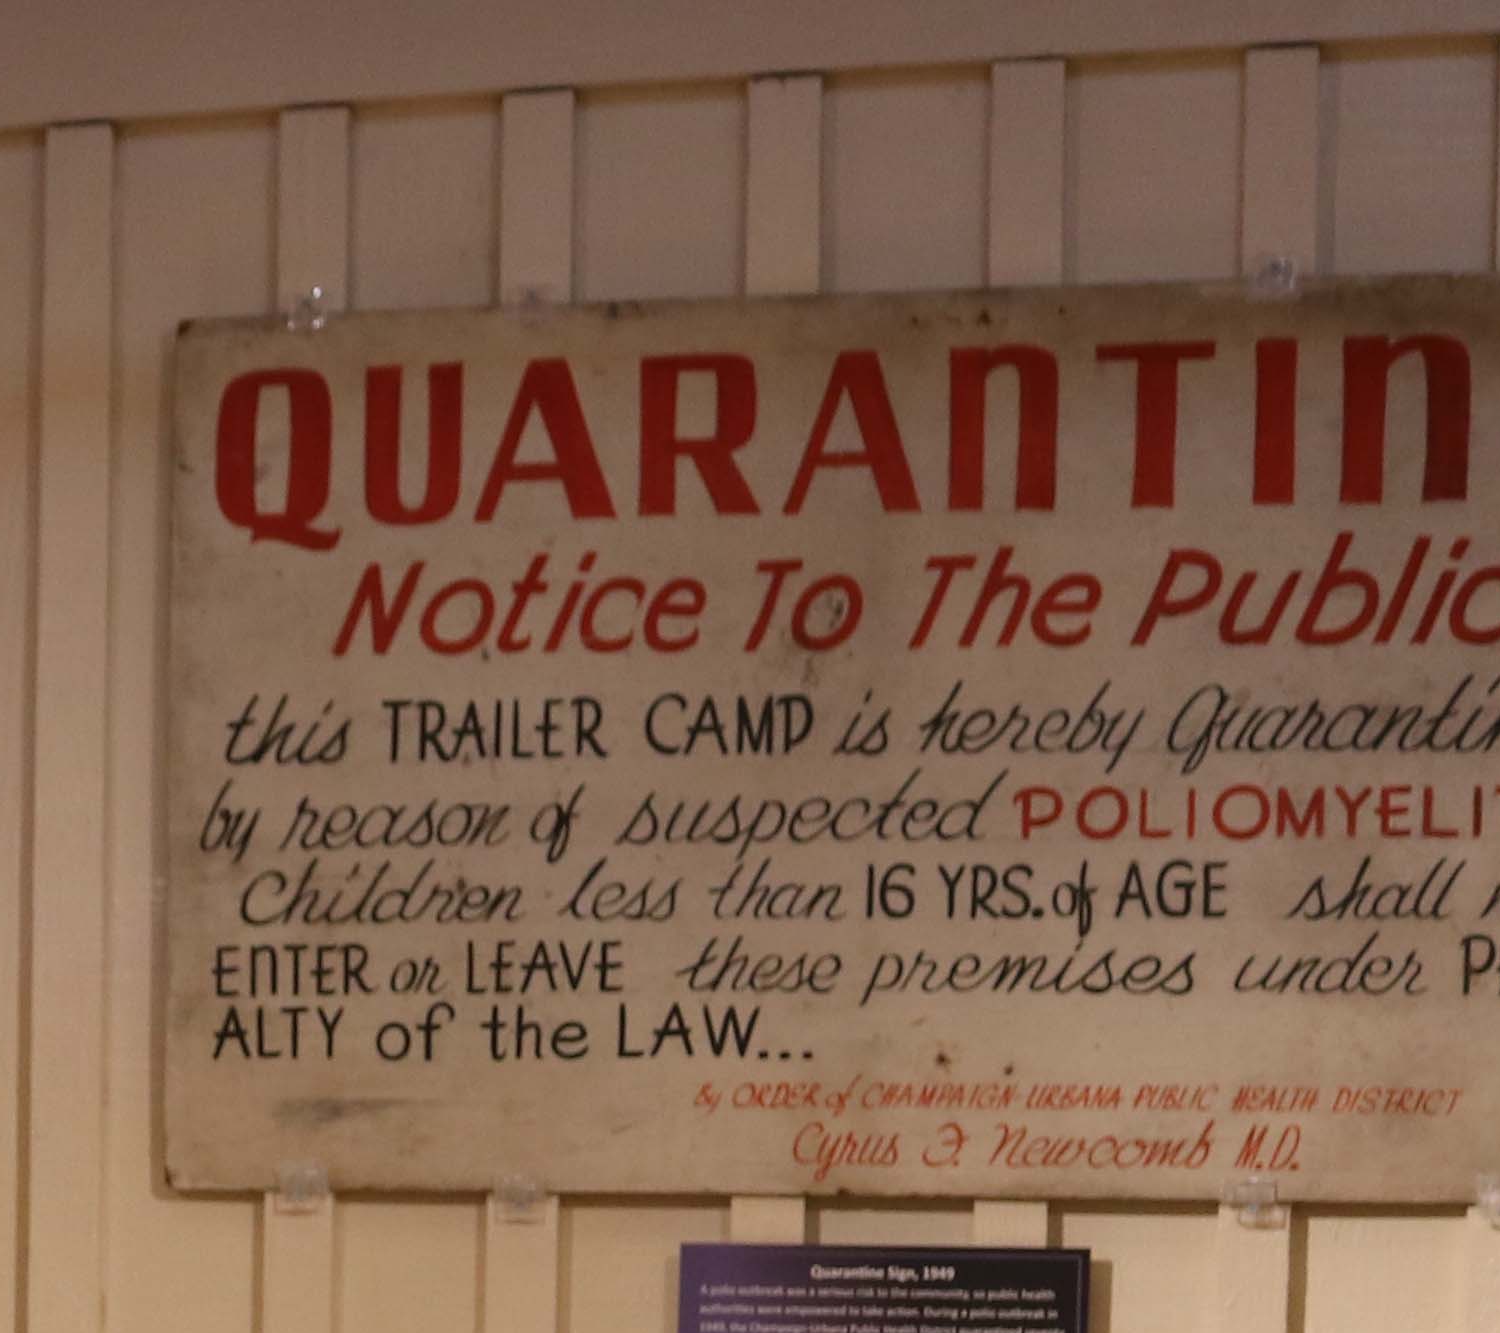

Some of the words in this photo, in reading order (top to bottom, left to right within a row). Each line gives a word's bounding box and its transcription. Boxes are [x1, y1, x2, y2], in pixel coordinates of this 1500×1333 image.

[331, 548, 709, 661] Notice
[742, 561, 863, 654] To
[908, 548, 1103, 654] The
[223, 692, 350, 764] this
[381, 698, 607, 762] TRAILER
[644, 692, 812, 755] CAMP
[834, 689, 892, 753] is
[918, 679, 1147, 774] hereby
[199, 777, 259, 862] by
[280, 796, 511, 850] reason
[530, 782, 586, 862] of
[617, 768, 1008, 858] suspected
[240, 857, 524, 928] Children
[560, 858, 678, 921] less
[707, 858, 845, 920] than
[865, 864, 915, 918] 16
[1115, 860, 1230, 919] AGE
[1287, 855, 1466, 921] shall
[389, 949, 444, 993] or
[465, 939, 623, 995] LEAVE
[675, 935, 842, 993] these
[860, 943, 1199, 1004] premises
[1233, 931, 1429, 997] under
[212, 1005, 342, 1061] ALTY
[374, 1003, 454, 1061] of
[480, 1003, 588, 1061] the
[616, 1003, 814, 1060] LAW...
[732, 1082, 820, 1109] ORDER
[824, 1073, 862, 1118] of
[1133, 1083, 1219, 1112] PUBLIC
[1231, 1084, 1319, 1113] HEALTH
[1331, 1085, 1462, 1116] DISTRICT
[989, 1119, 1213, 1169] Newcomb
[1233, 1124, 1299, 1170] M.D.
[810, 1263, 883, 1282] Quarantine
[887, 1265, 919, 1283] Sign,
[923, 1265, 954, 1280] 1949
